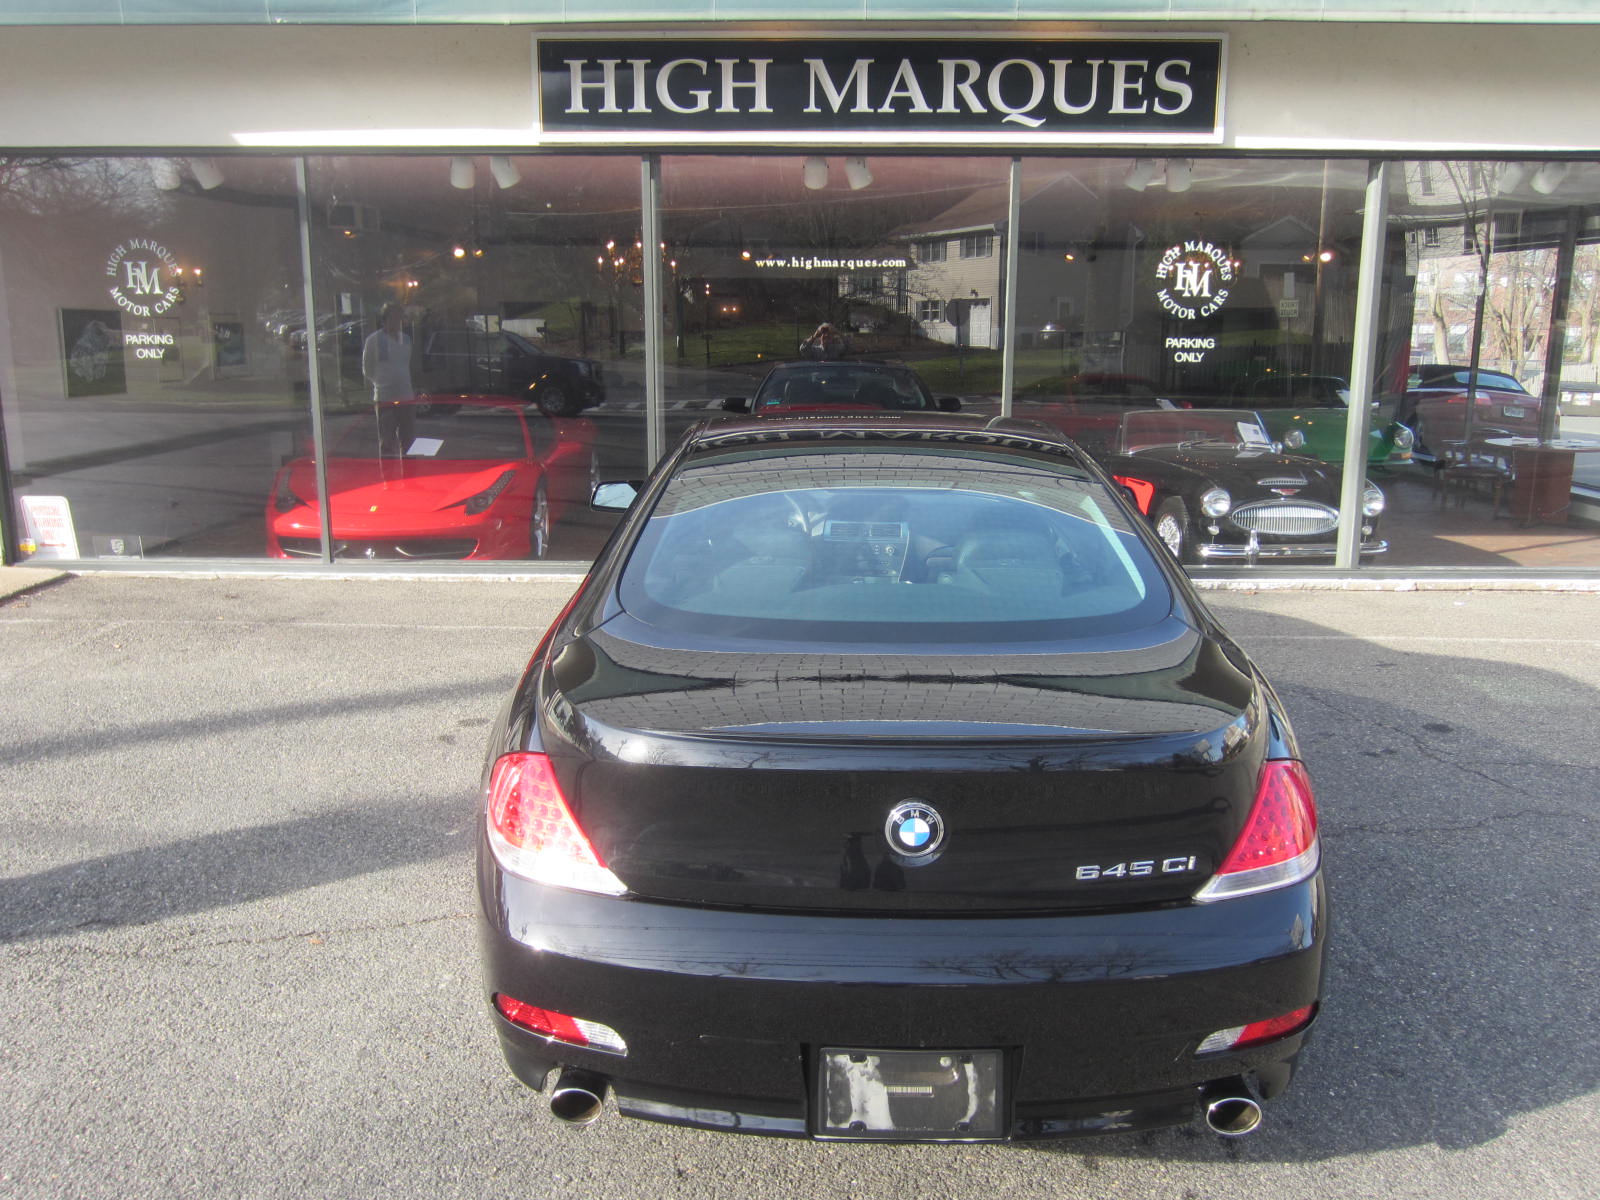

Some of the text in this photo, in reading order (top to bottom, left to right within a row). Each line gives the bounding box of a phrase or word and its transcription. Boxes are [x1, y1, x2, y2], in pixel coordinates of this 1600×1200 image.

[563, 58, 1193, 128] HIGH MARQUES
[106, 238, 181, 278] HIGH MARQUES
[755, 256, 906, 270] www.highmarques.com
[1156, 240, 1232, 281] HIGH MARQUES
[109, 286, 180, 317] MOTOR CARS
[1157, 288, 1229, 320] MOTOR CARS
[125, 334, 174, 345] PARKING
[1165, 338, 1215, 349] PARKING
[136, 348, 165, 359] ONLY
[1174, 351, 1205, 363] ONLY
